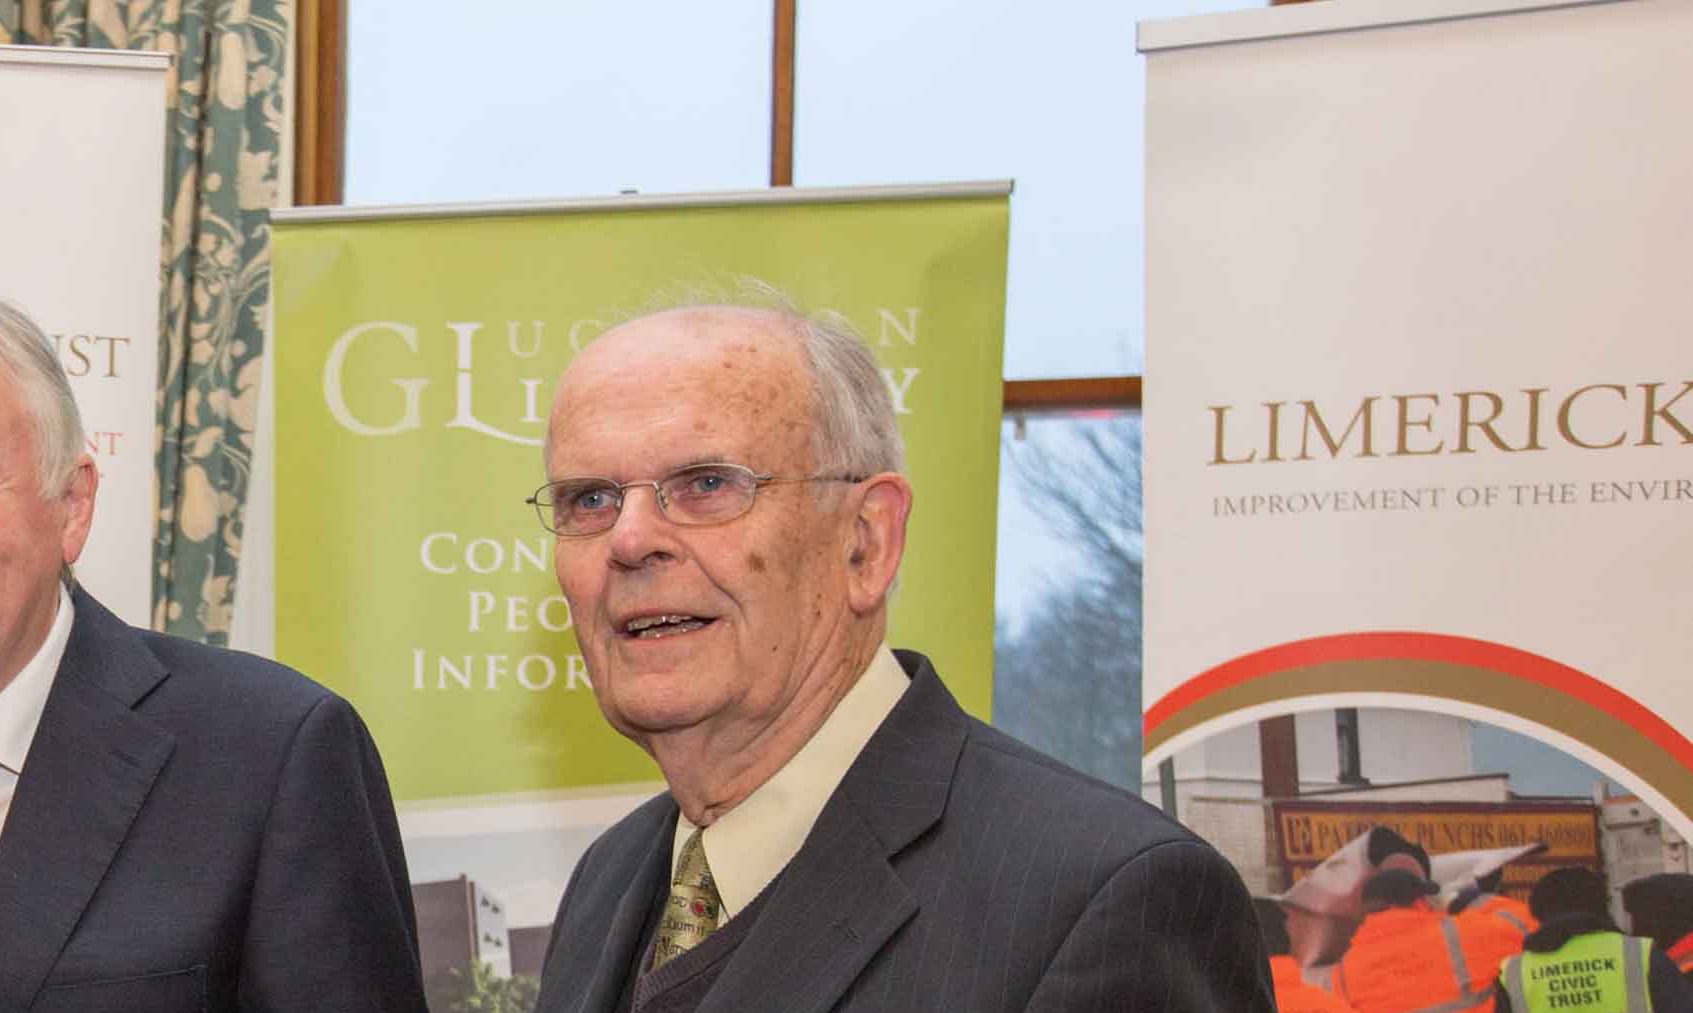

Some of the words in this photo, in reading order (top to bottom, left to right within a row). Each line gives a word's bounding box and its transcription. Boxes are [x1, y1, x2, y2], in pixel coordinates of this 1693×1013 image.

[1206, 380, 1693, 467] LIMERICK
[1212, 486, 1445, 519] IMPROVEMENT
[1455, 484, 1500, 510] OF
[1508, 482, 1579, 507] THE
[1589, 478, 1693, 503] ENVIR
[1530, 957, 1616, 982] LIMERICK
[1548, 974, 1598, 993] CIVIC
[1548, 989, 1603, 1009] TRUST
